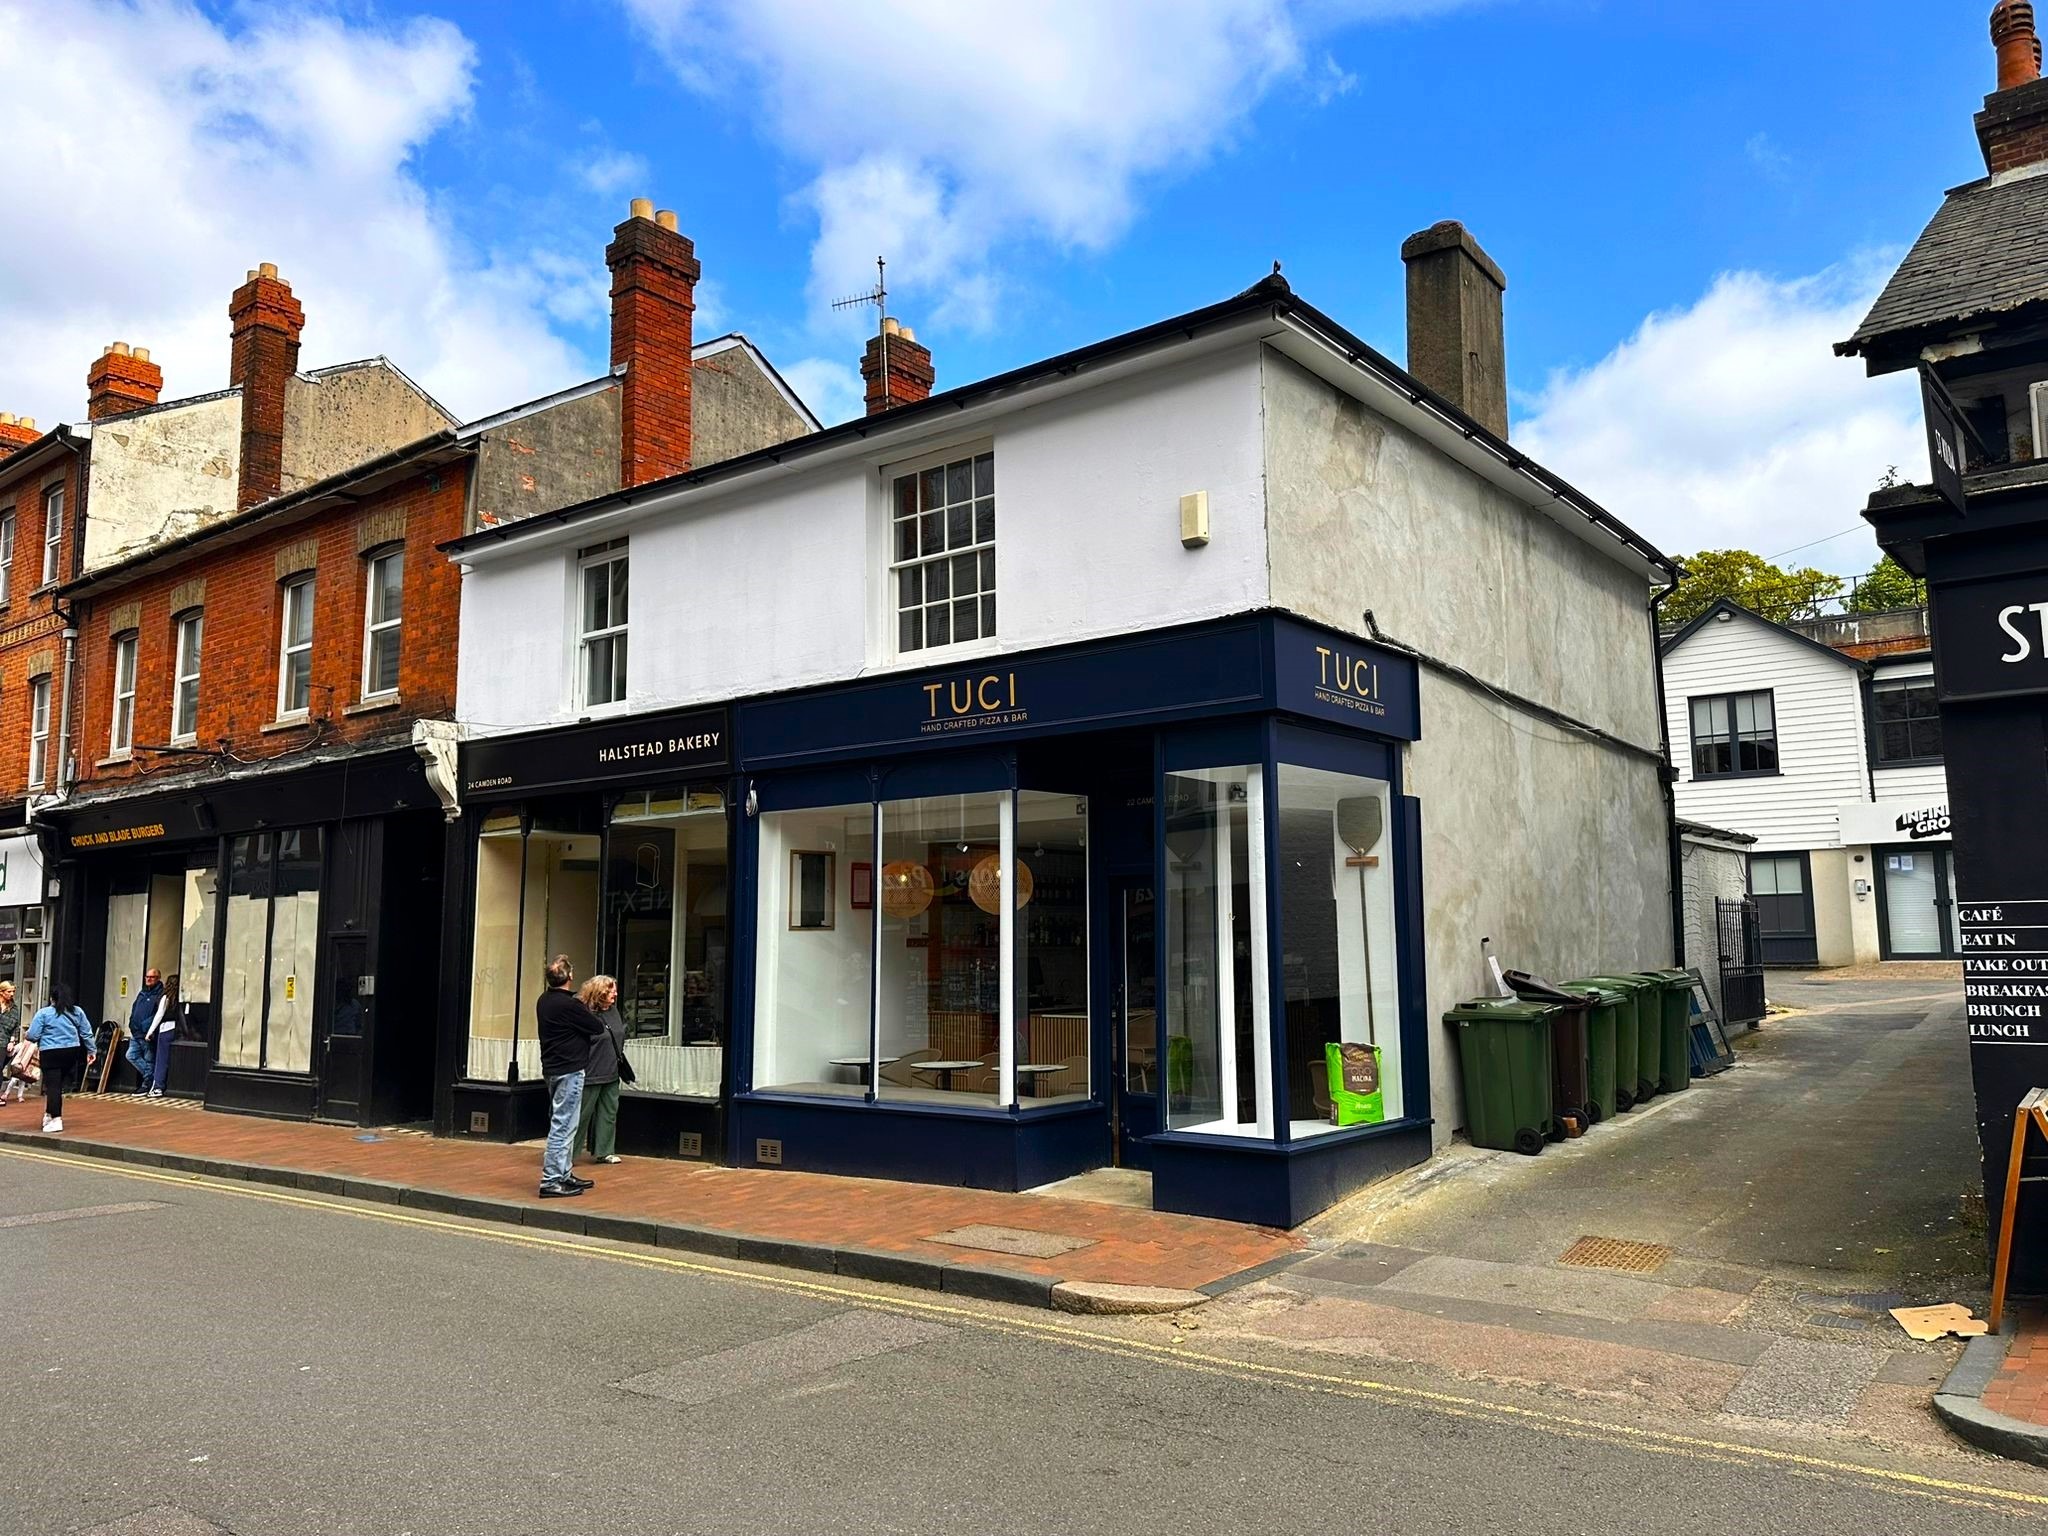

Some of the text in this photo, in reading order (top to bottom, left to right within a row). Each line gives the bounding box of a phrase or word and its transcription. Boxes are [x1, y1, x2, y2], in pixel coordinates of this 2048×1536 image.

[1316, 646, 1378, 699] TUCI
[923, 673, 1015, 717] TUCI
[1315, 690, 1330, 702] HAND
[1331, 695, 1354, 709] CRAFTED
[1355, 701, 1369, 713] PIZZA
[1375, 707, 1385, 717] BAR
[921, 712, 1028, 733] HAND CRAFTED PIZZA & BAR
[599, 732, 720, 762] HALSTEAD BAKERY
[475, 779, 497, 789] CAMDEN
[497, 776, 512, 785] ROAD
[71, 823, 165, 847] CHUCK AND BLADE BURGERS
[1959, 906, 2003, 921] CAFÉ
[1961, 933, 2016, 946] EAT IN
[1964, 959, 2048, 971] TAKE OUT
[1967, 1004, 2042, 1017] BRUNCH
[1969, 1024, 2030, 1037] LUNCH
